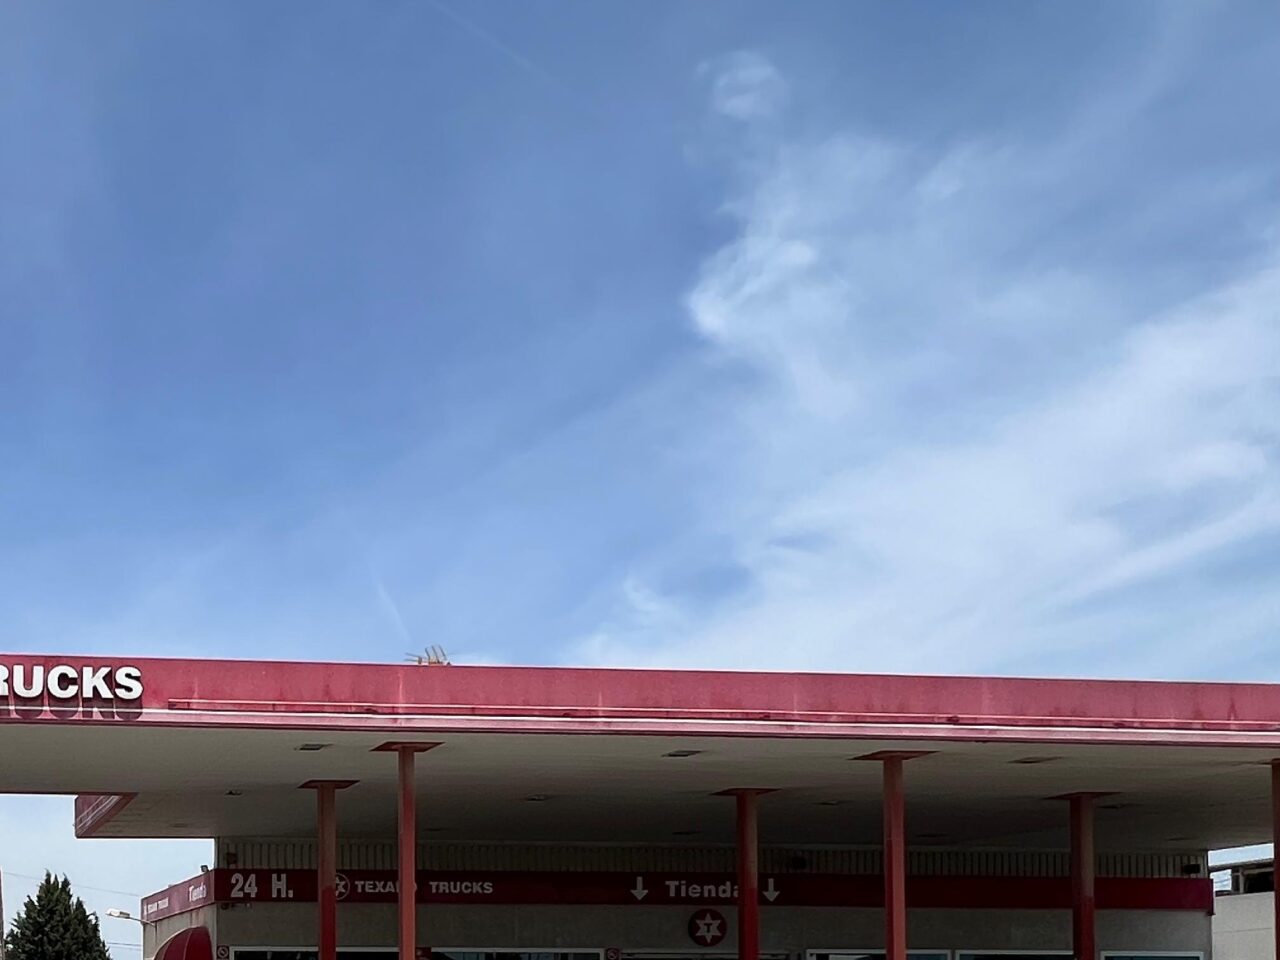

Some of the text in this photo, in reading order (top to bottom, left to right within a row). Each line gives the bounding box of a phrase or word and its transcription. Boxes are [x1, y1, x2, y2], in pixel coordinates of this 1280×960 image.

[230, 873, 258, 898] 24
[354, 880, 494, 894] TEXA TRUCKS
